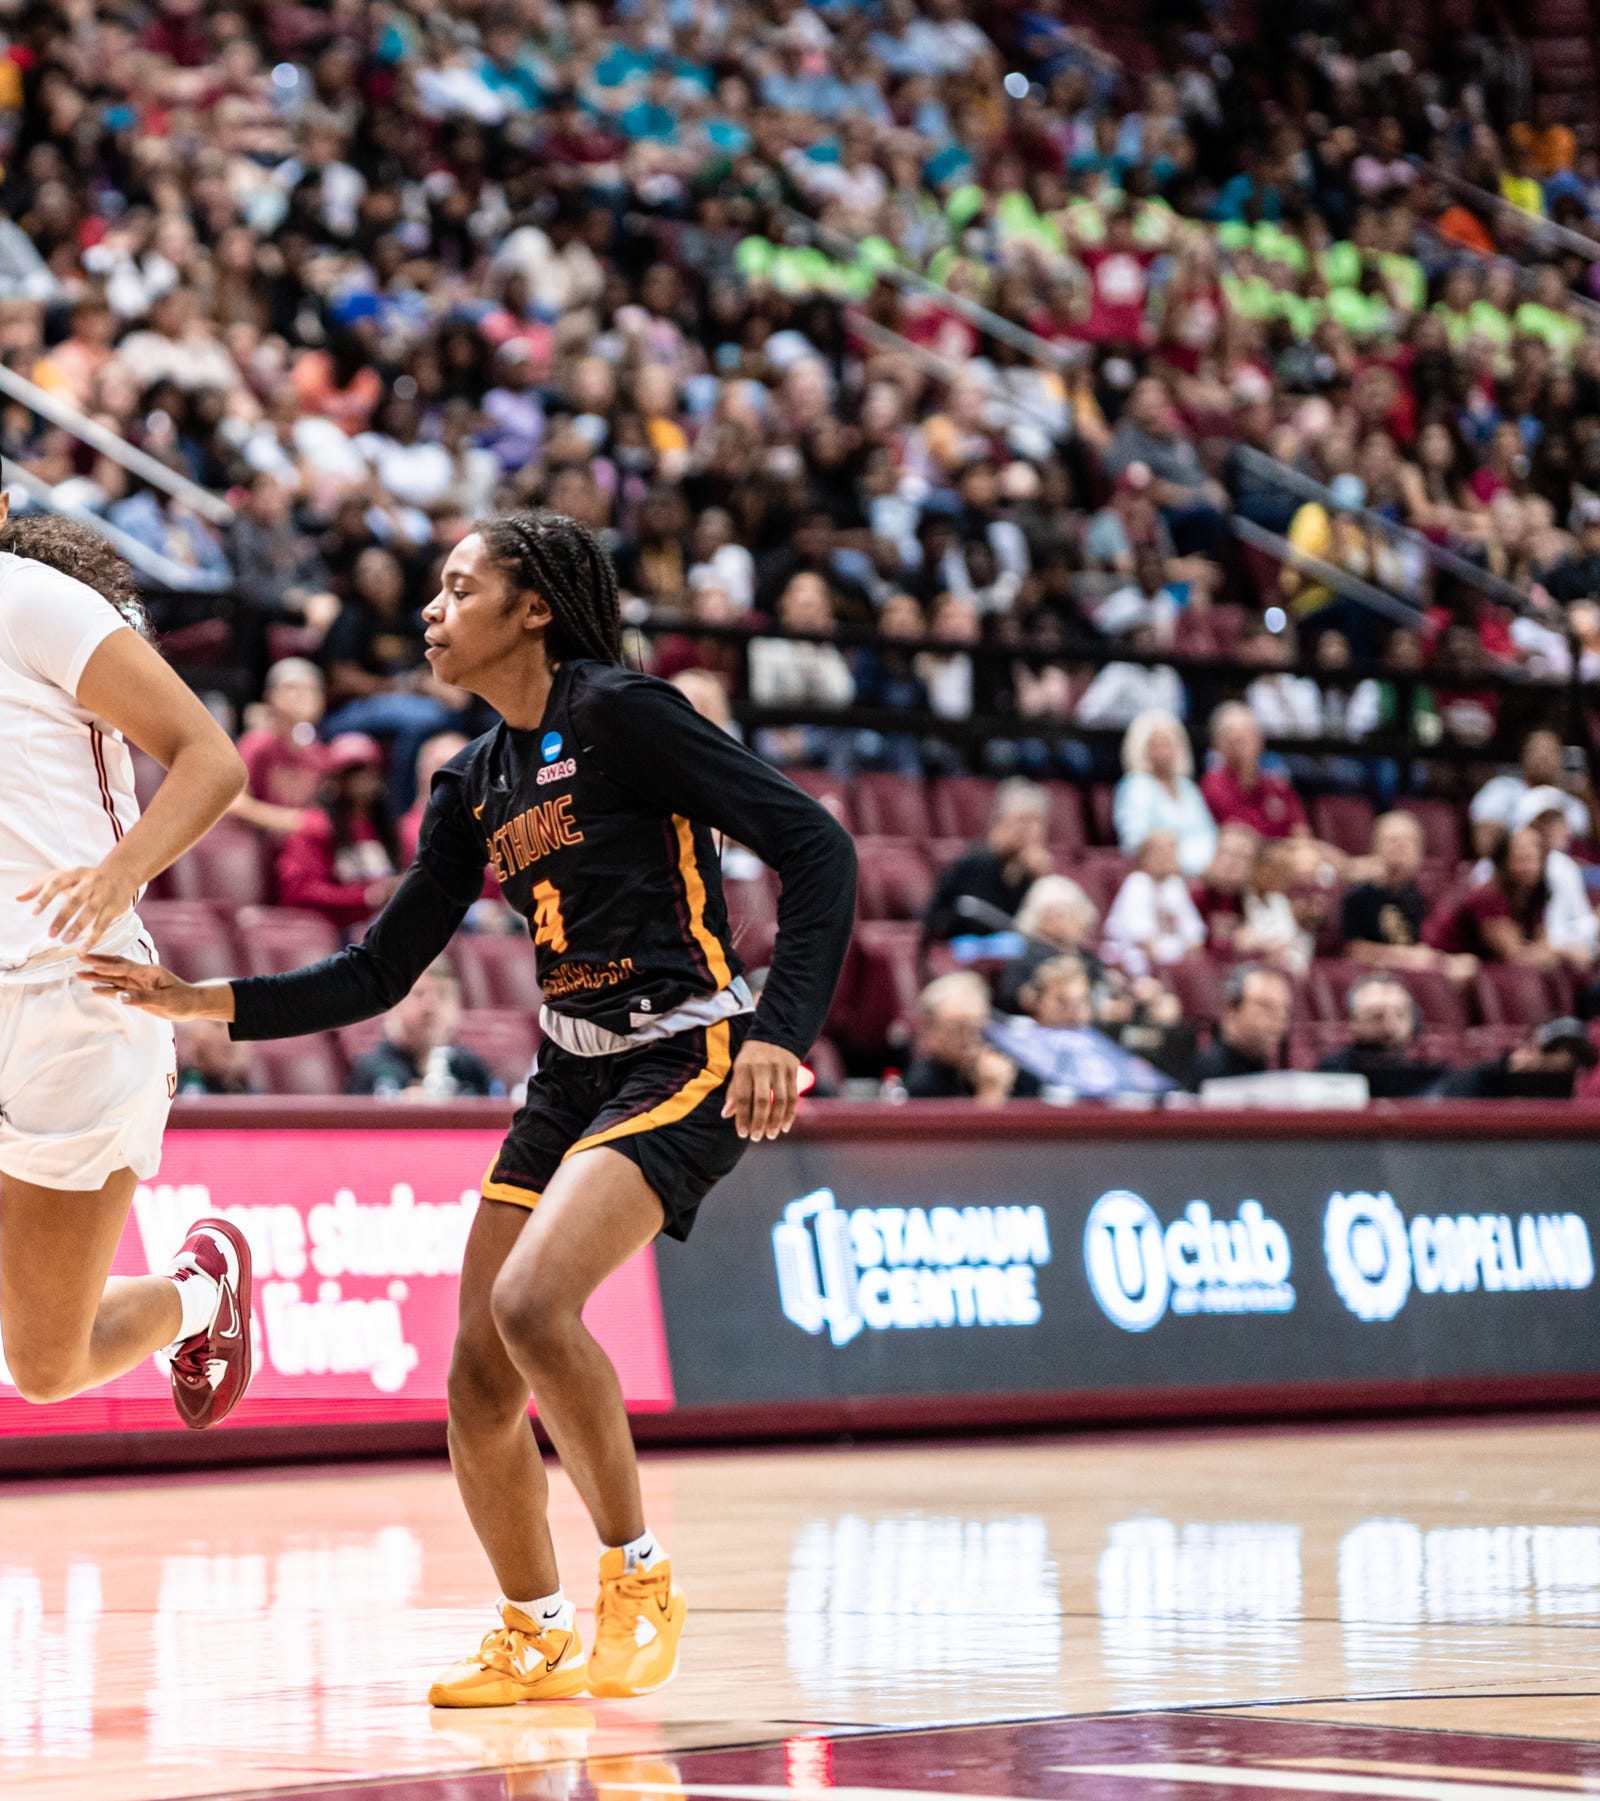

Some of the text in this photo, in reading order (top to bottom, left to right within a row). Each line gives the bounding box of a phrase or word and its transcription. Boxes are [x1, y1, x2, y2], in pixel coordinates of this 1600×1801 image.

[536, 758, 577, 785] SWAC
[532, 879, 568, 954] 4
[850, 1205, 1050, 1269] STADIUM
[1409, 1213, 1595, 1293] COPELAND
[858, 1264, 1042, 1330] CENTRE
